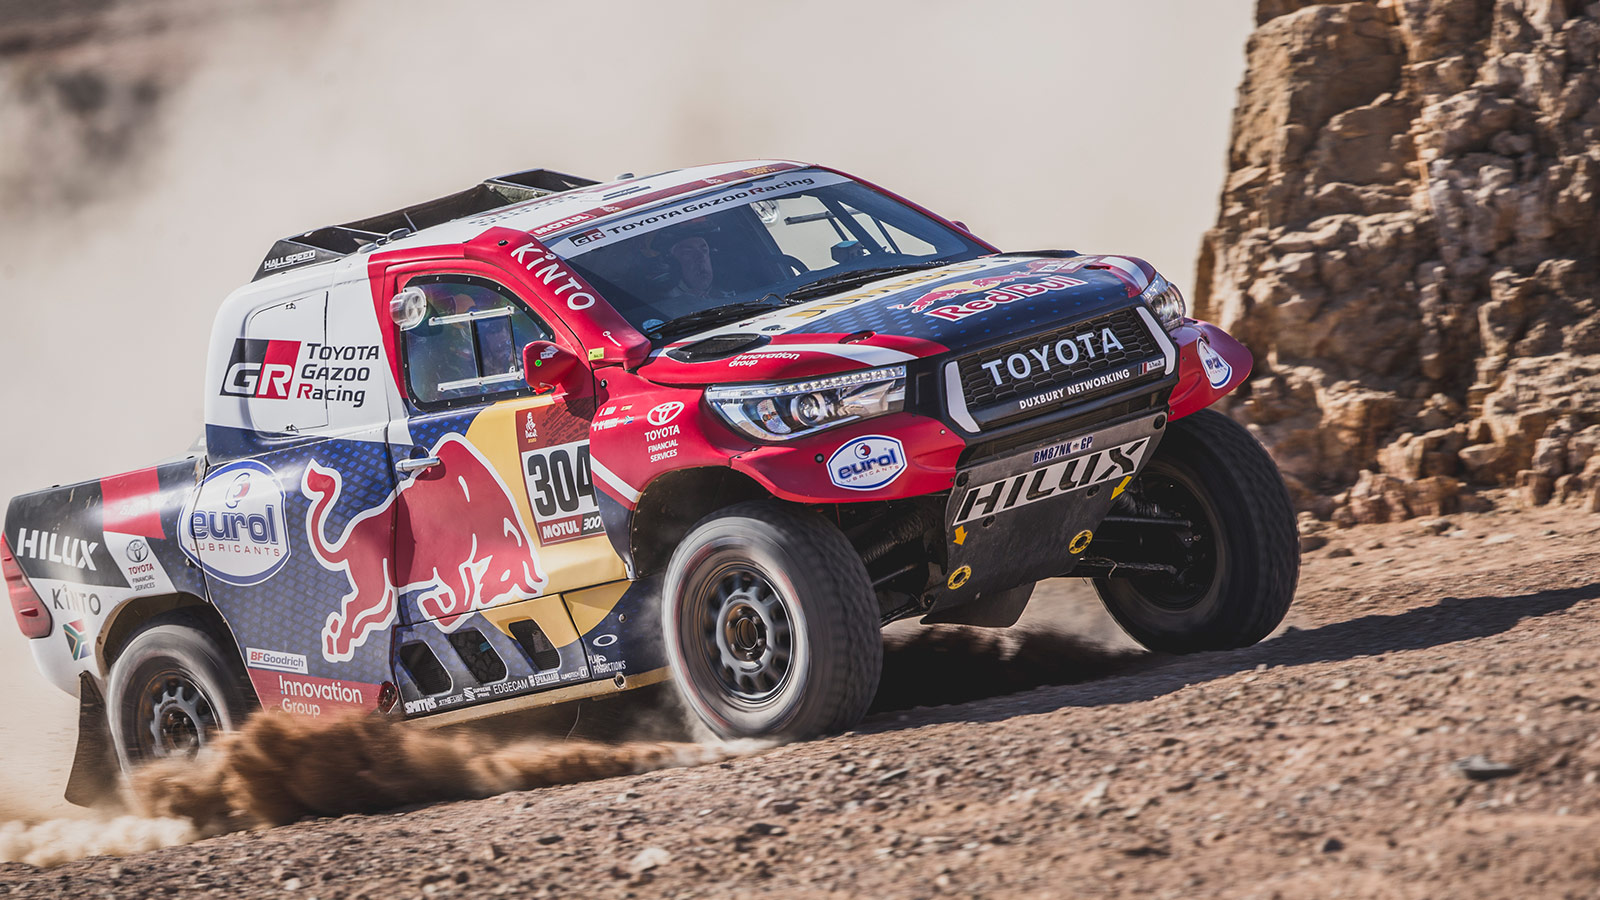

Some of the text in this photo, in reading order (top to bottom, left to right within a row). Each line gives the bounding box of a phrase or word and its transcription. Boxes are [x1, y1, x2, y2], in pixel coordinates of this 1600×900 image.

[573, 233, 604, 247] GR
[606, 211, 681, 235] TOYOTA
[682, 192, 748, 213] GAZOO
[748, 177, 815, 195] Racing
[533, 214, 590, 235] MOTUL
[264, 249, 316, 270] HALLSPEED
[306, 342, 380, 361] TOYOTA
[981, 327, 1124, 386] TOYOTA
[223, 362, 293, 397] GR
[300, 363, 371, 382] GAZOO
[296, 383, 366, 408] Racing
[1019, 368, 1131, 410] DUXBURY NETWORKING
[644, 424, 681, 442] TOYOTA
[647, 439, 679, 453] FINANCIAL
[650, 448, 678, 462] SERVICES
[1033, 436, 1093, 464] BM87NK GP
[838, 447, 899, 480] eurol
[527, 444, 600, 517] 304
[840, 464, 900, 485] LUBRICANTS
[955, 439, 1148, 523] HILUX
[188, 504, 279, 545] eurol
[542, 520, 580, 539] MOTUL
[16, 527, 99, 571] HILUX
[189, 543, 281, 557] LUBRICANTS
[128, 563, 154, 575] TOYOTA
[250, 651, 304, 668] BFGoodrich
[492, 679, 529, 695] EDGECAM
[282, 697, 321, 718] Group
